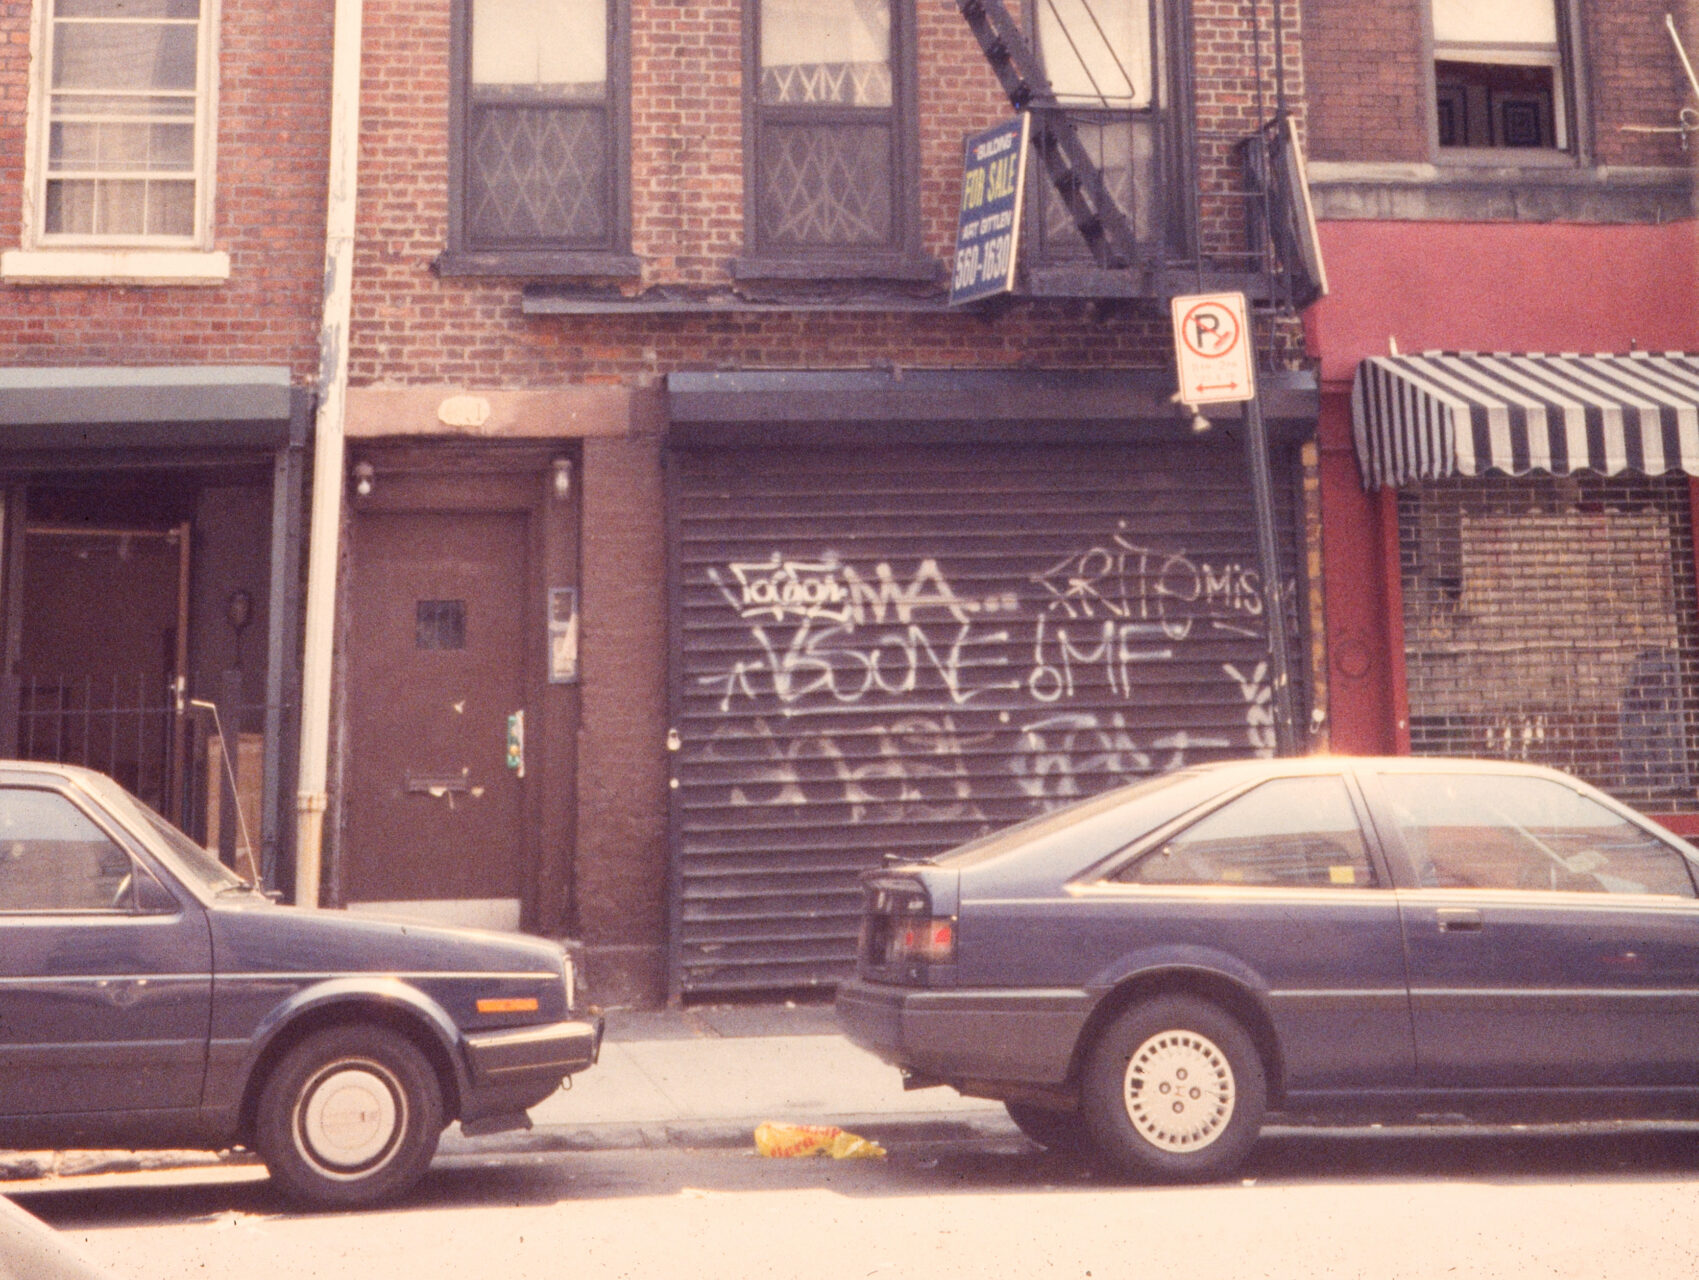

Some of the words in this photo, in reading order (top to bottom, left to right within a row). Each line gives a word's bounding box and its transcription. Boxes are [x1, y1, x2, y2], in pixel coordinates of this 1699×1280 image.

[977, 132, 1013, 161] BUILDING
[963, 166, 985, 211] FOR
[987, 152, 1017, 202] SALE
[955, 233, 1010, 292] 560-1630
